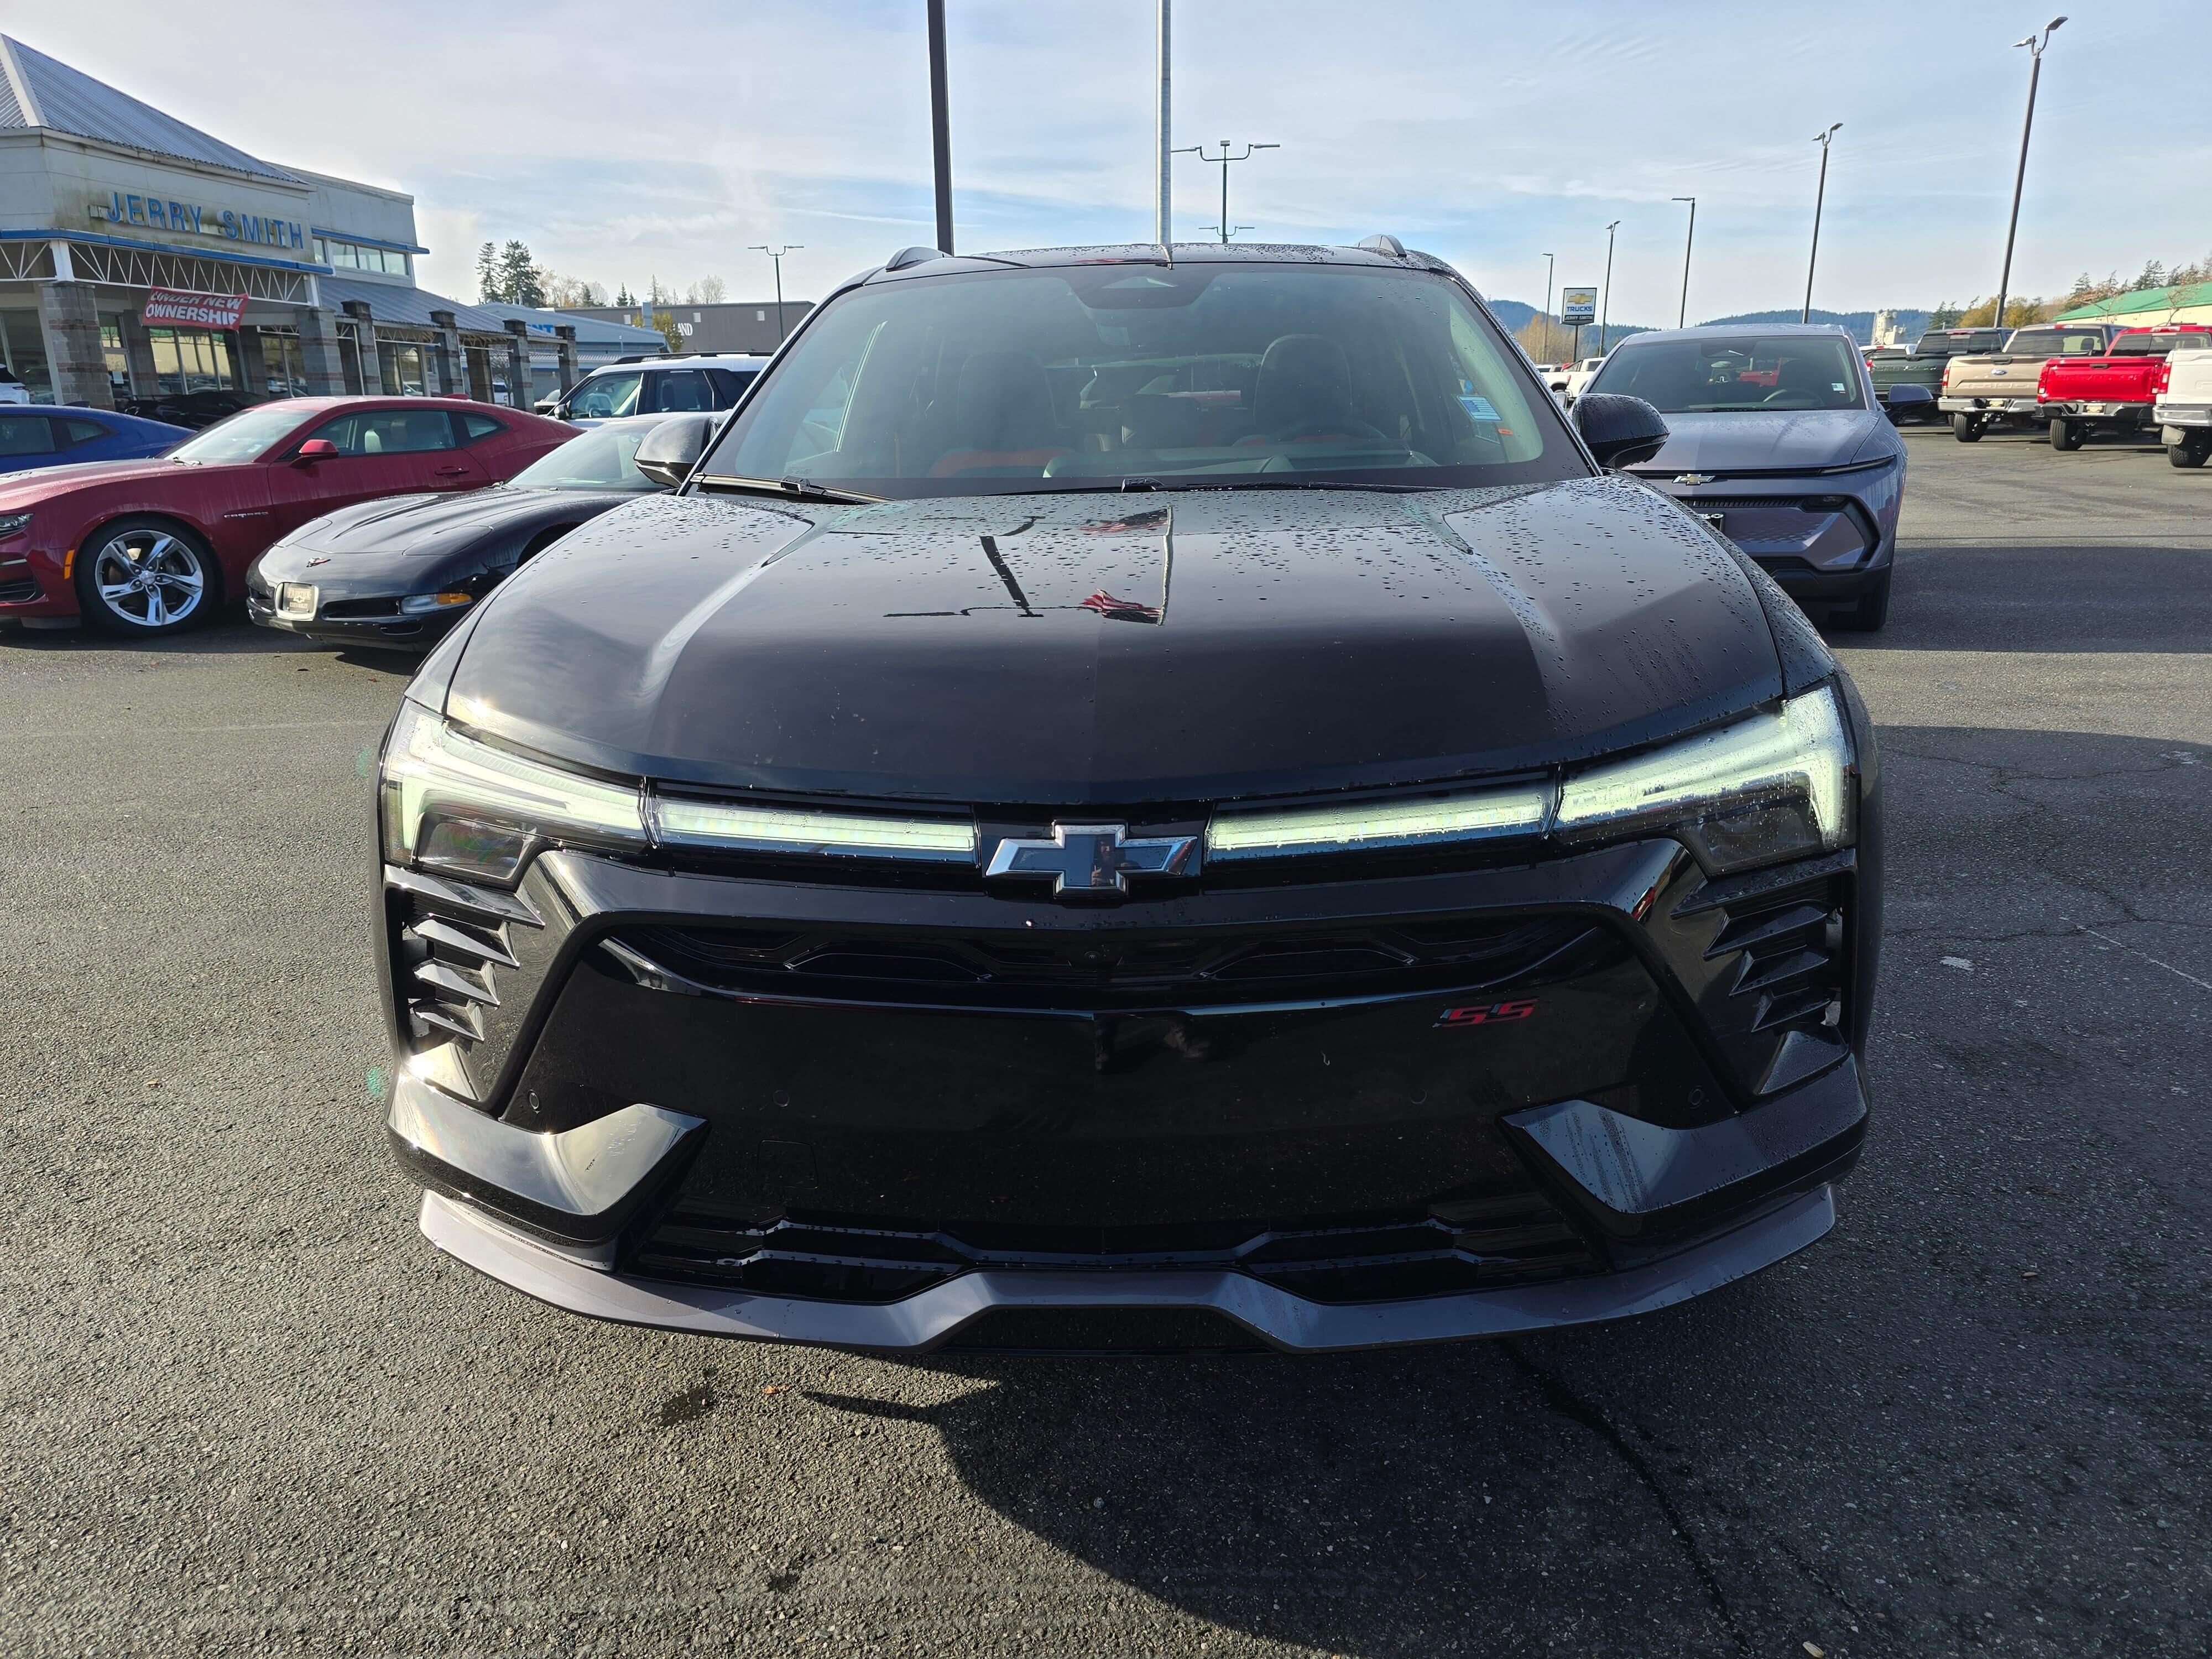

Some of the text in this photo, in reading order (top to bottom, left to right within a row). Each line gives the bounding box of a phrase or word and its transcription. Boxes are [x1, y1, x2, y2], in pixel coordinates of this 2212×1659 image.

[107, 191, 304, 249] JERRY SMITH
[150, 291, 244, 310] UNDER NEW
[1432, 998, 1539, 1028] SS
